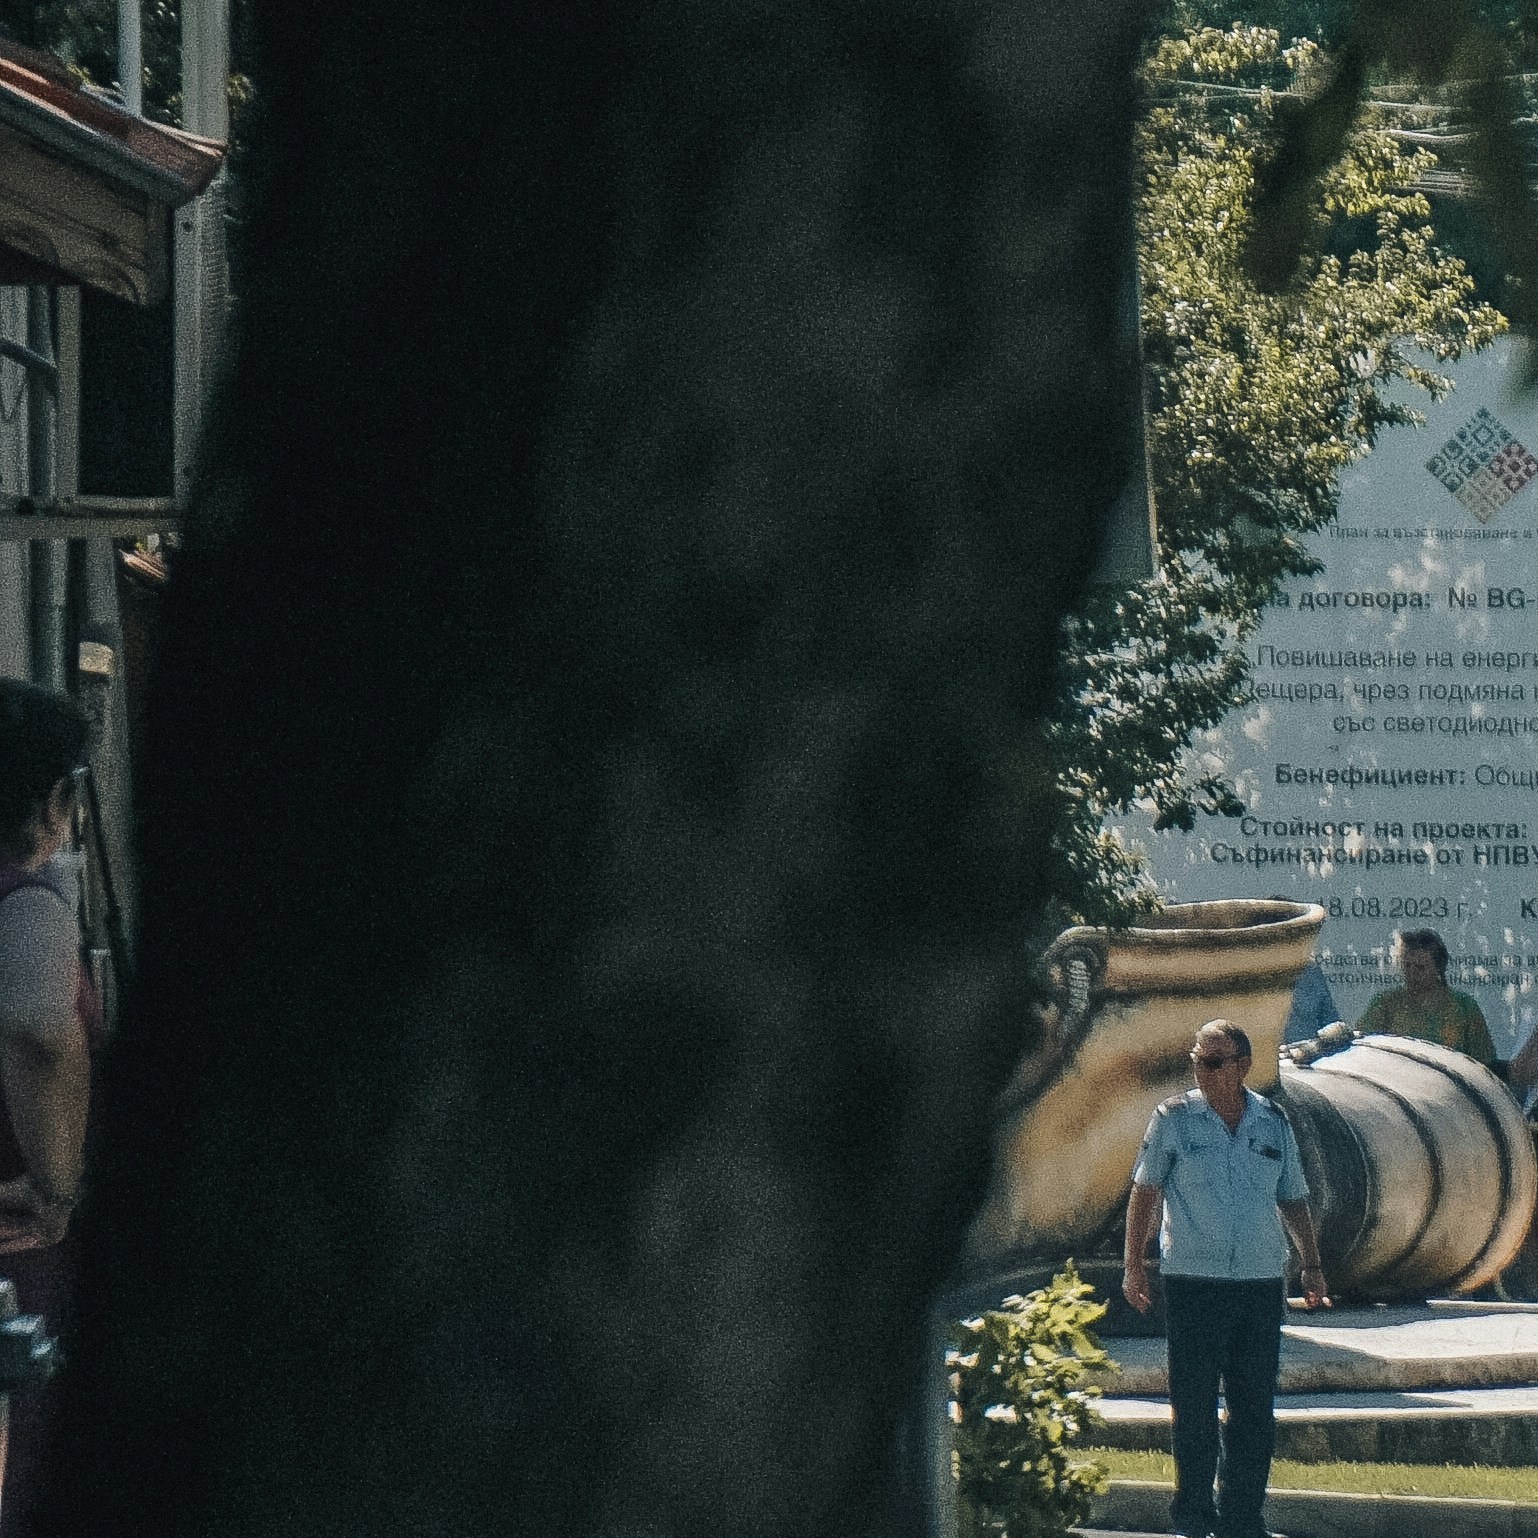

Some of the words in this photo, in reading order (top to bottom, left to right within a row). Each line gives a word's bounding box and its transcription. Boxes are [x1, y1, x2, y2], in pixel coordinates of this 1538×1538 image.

[1299, 591, 1431, 613] договора:
[1449, 587, 1478, 609] №
[1425, 650, 1454, 667] на
[1248, 680, 1345, 705] ещера,
[1353, 682, 1410, 706] чрез
[1418, 682, 1525, 706] подмяна
[1333, 714, 1376, 732] със
[1275, 763, 1466, 791] Бенефициент:
[1240, 816, 1365, 838] Стойност
[1375, 820, 1403, 838] на
[1412, 820, 1528, 845] проекта:
[1210, 842, 1428, 869] Съфинансиране
[1436, 846, 1465, 865] от
